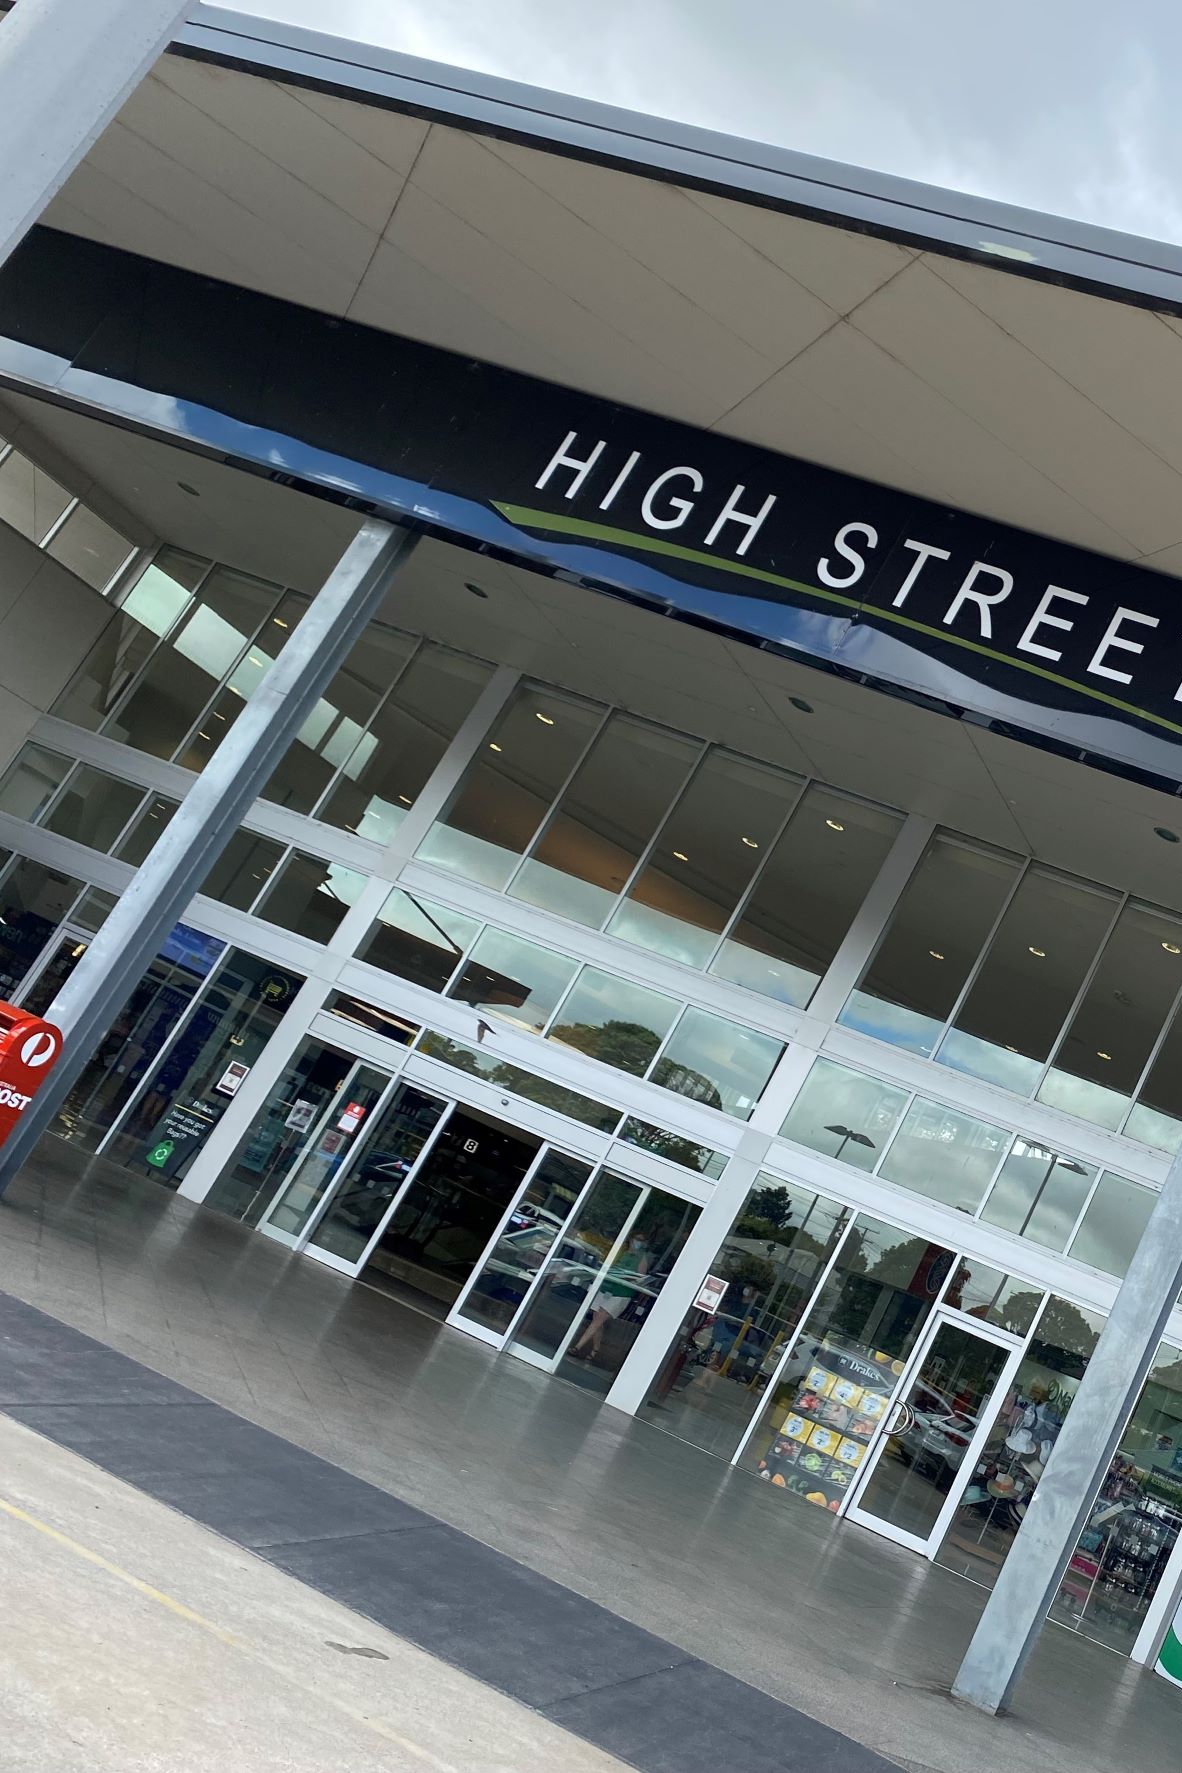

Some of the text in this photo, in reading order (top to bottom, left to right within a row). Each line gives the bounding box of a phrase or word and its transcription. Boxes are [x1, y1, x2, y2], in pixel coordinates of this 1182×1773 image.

[535, 431, 777, 556] HIGH
[0, 1087, 32, 1111] OST
[163, 1118, 177, 1127] your
[183, 1116, 195, 1125] you
[194, 1120, 206, 1130] got
[849, 1358, 881, 1382] Drakes
